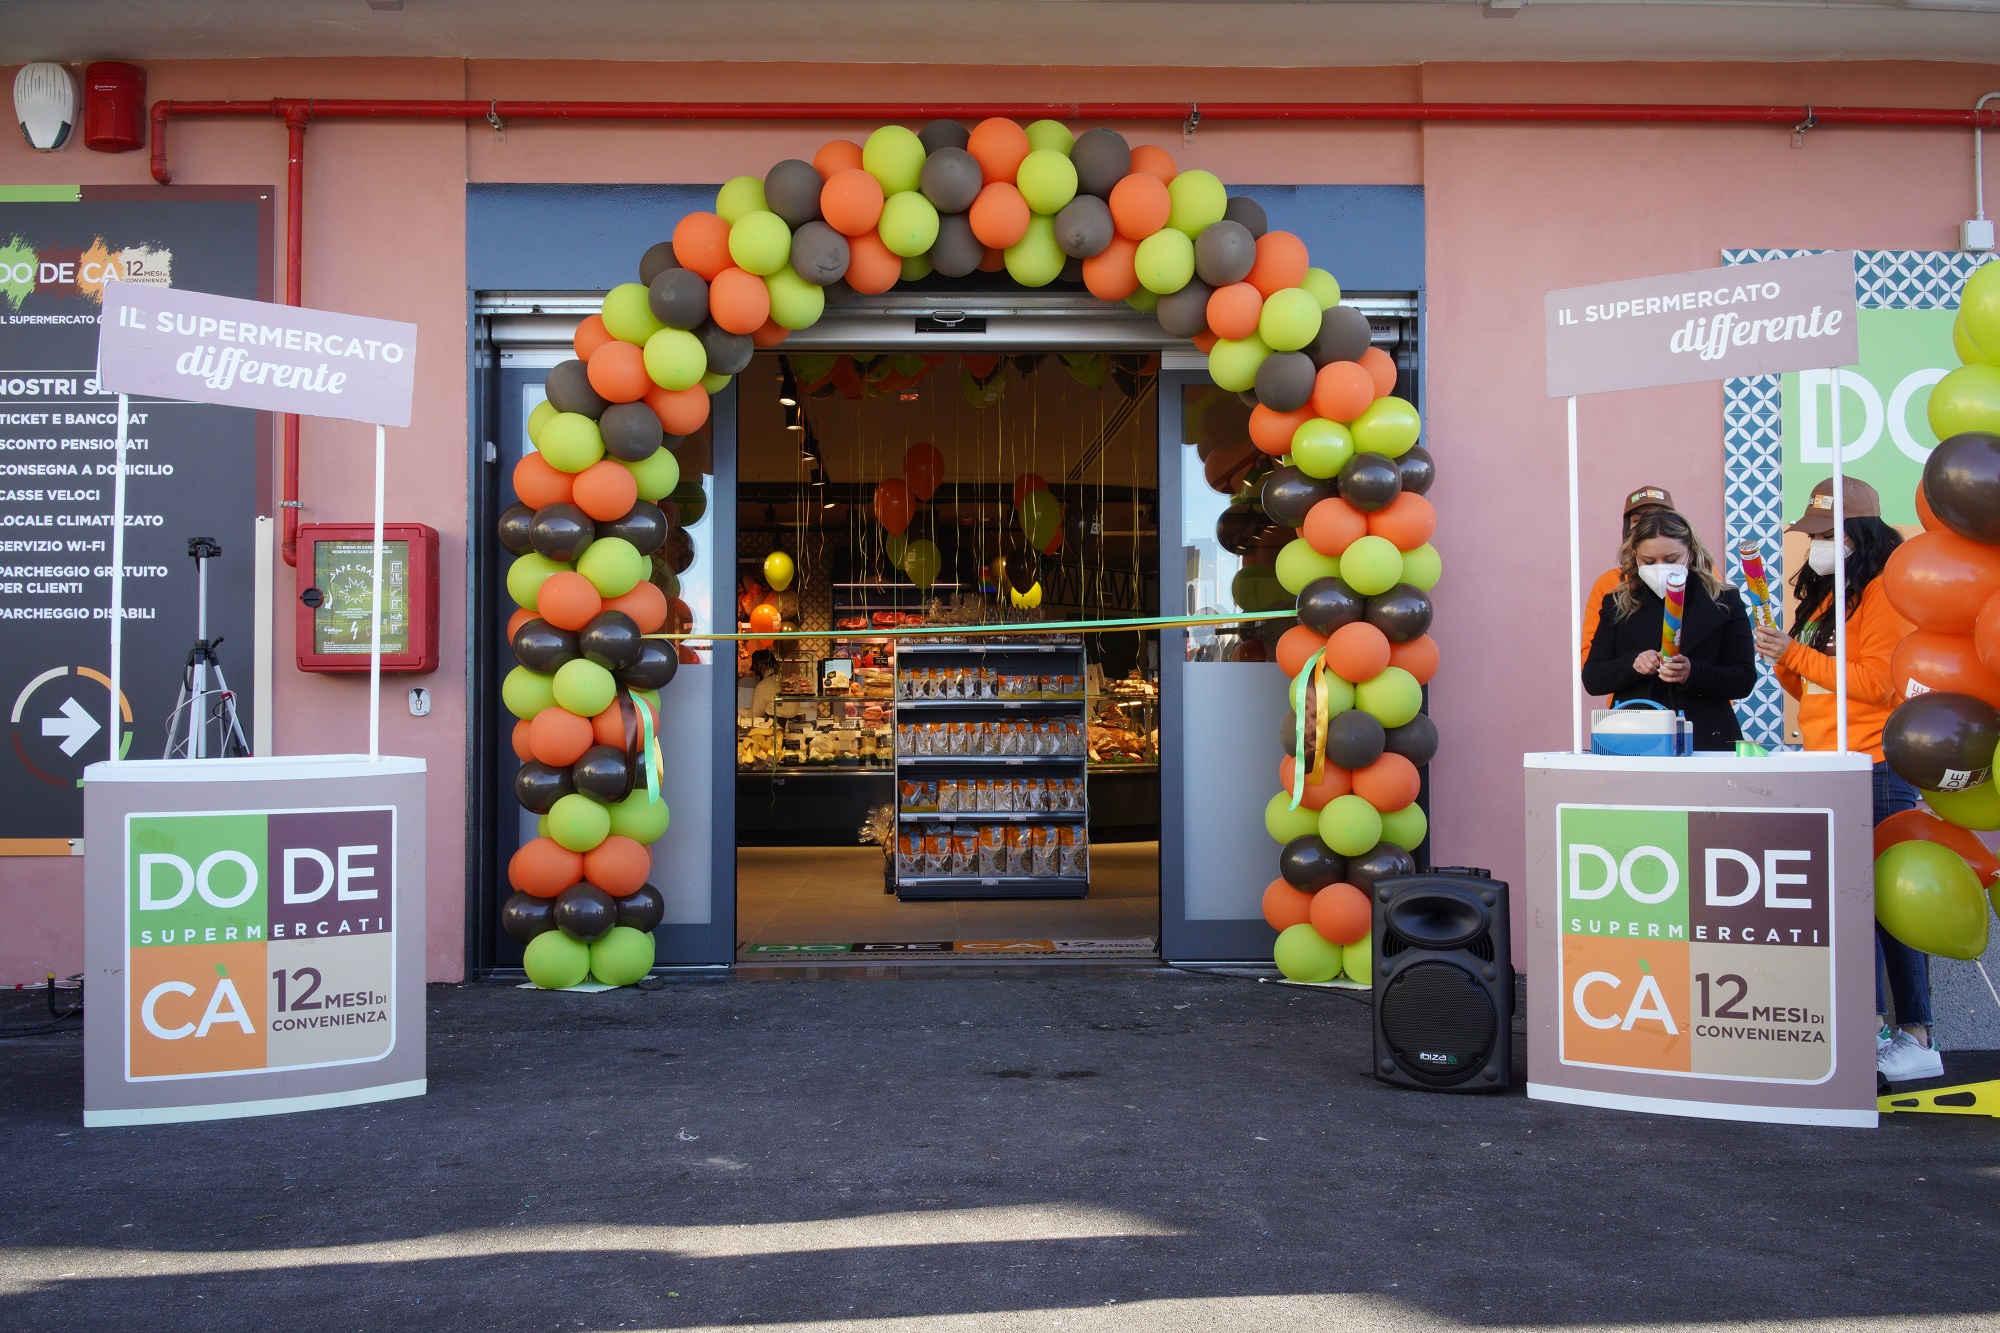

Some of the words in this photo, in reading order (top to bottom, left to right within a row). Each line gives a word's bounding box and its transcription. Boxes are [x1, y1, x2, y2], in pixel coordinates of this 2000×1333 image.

[40, 262, 75, 284] DE
[126, 260, 144, 277] 12
[1558, 308, 1579, 326] IL
[1585, 281, 1781, 323] SUPERMERCATO
[9, 315, 95, 325] SUPERMERCATO
[119, 305, 147, 330] IL
[156, 311, 404, 364] SUPERMERCATO
[1670, 304, 1843, 361] differente
[175, 345, 347, 395] differente
[0, 413, 49, 425] TICKET
[53, 413, 61, 425] E
[65, 413, 148, 425] BANCOAT
[0, 438, 57, 450] SCONTO
[61, 438, 148, 450] PENSIOATI
[0, 464, 78, 476] CONSEGNA
[82, 464, 92, 476] A
[0, 489, 43, 501] CASSE
[47, 489, 100, 501] VELOCI
[57, 515, 164, 527] CLIMATIZATO
[67, 540, 105, 552] WI-FI
[27, 583, 83, 594] CLIENTI
[139, 850, 258, 911] DO
[283, 844, 378, 904] DE
[1568, 843, 1680, 904] DO
[1704, 848, 1812, 909] DE
[141, 917, 383, 944] SUPERMERCATI
[1571, 918, 1818, 944] SUPERMERCATI
[141, 963, 256, 1040] CÀ
[272, 967, 323, 1013] 12
[325, 990, 373, 1009] MESI
[376, 995, 387, 1005] DI
[1572, 958, 1680, 1035] CÀ
[1695, 972, 1749, 1020] 12
[1752, 1006, 1808, 1024] MESI
[1811, 1014, 1825, 1024] DI
[272, 1010, 387, 1032] CONVENIENZA
[1695, 1024, 1825, 1043] CONVENIENZA
